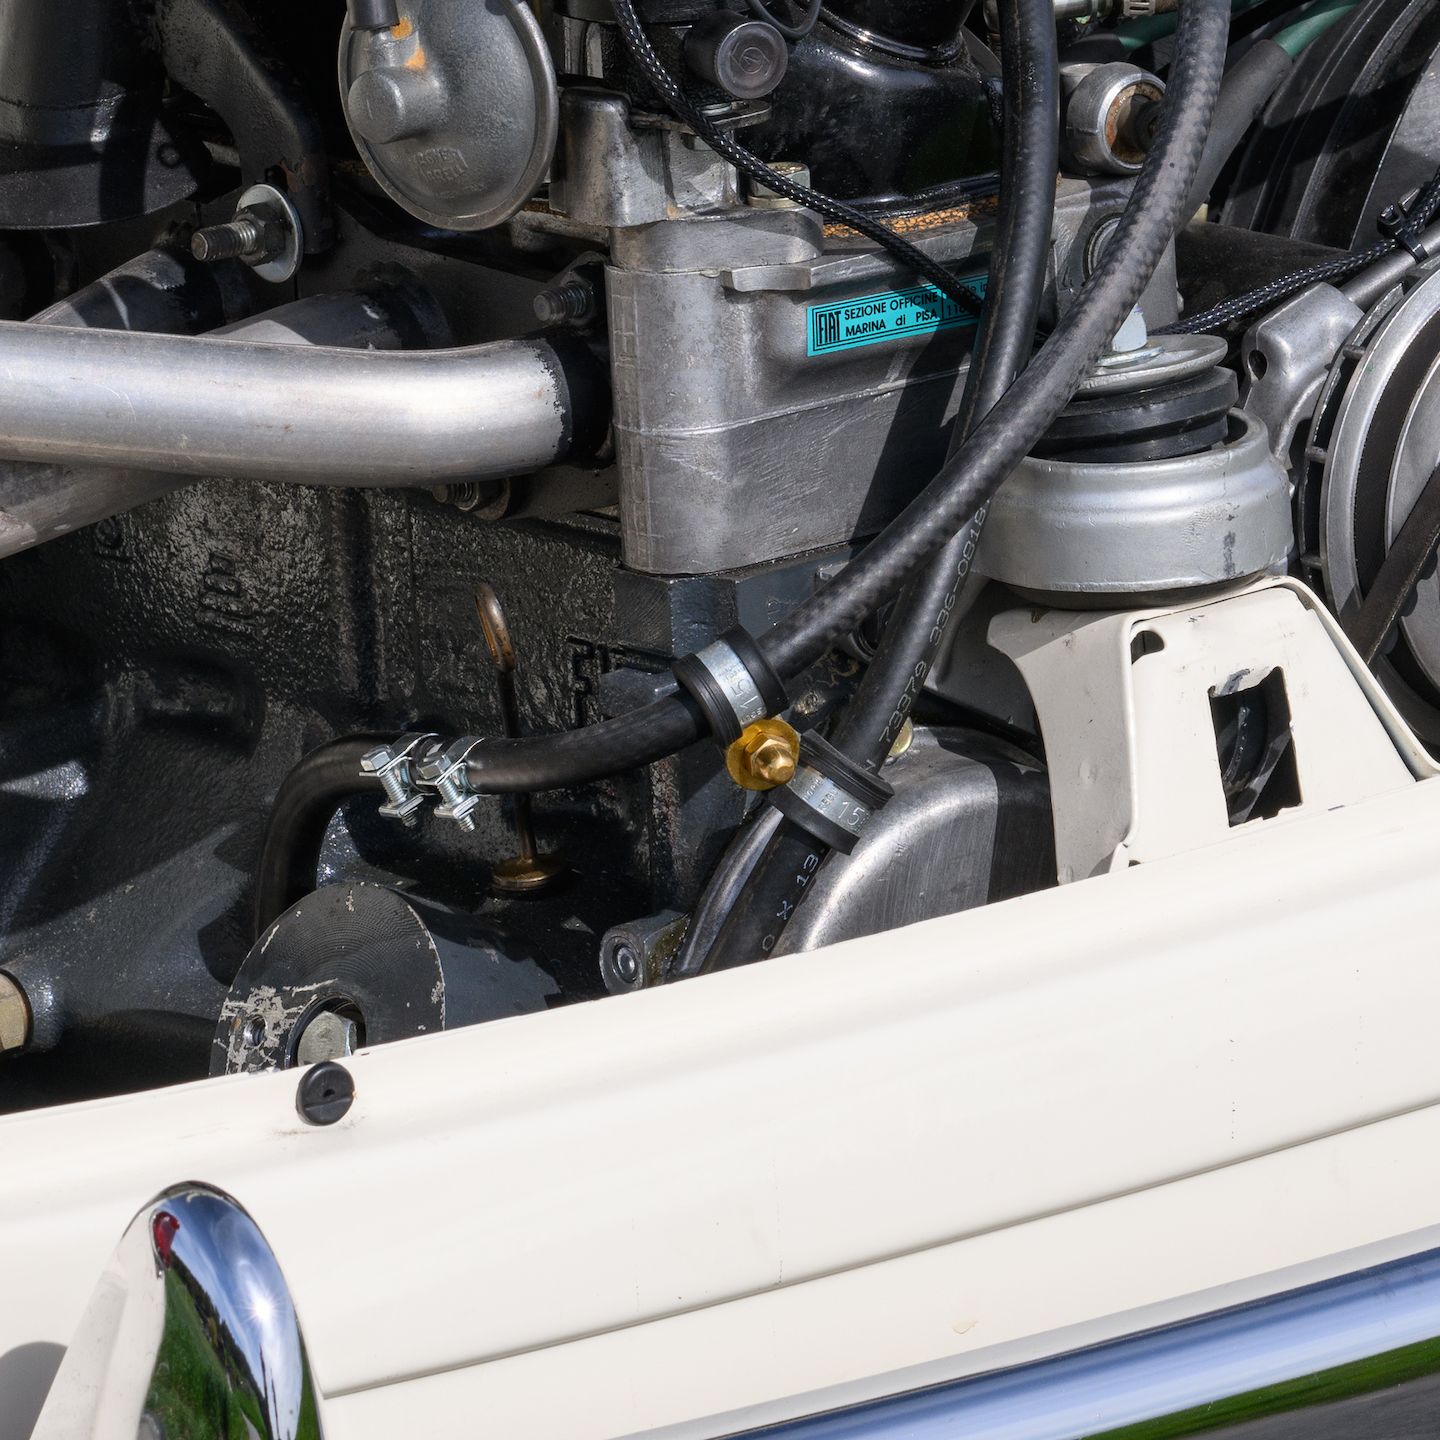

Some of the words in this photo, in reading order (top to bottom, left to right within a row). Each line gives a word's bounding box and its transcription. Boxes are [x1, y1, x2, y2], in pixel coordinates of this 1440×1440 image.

[844, 302, 887, 322] SEZIONE
[889, 291, 938, 312] OFFICINE
[817, 310, 842, 345] FIAT
[845, 319, 887, 338] MARINA
[895, 314, 906, 327] di
[915, 309, 938, 324] PISA
[879, 660, 927, 743] 73379
[838, 800, 866, 827] 15
